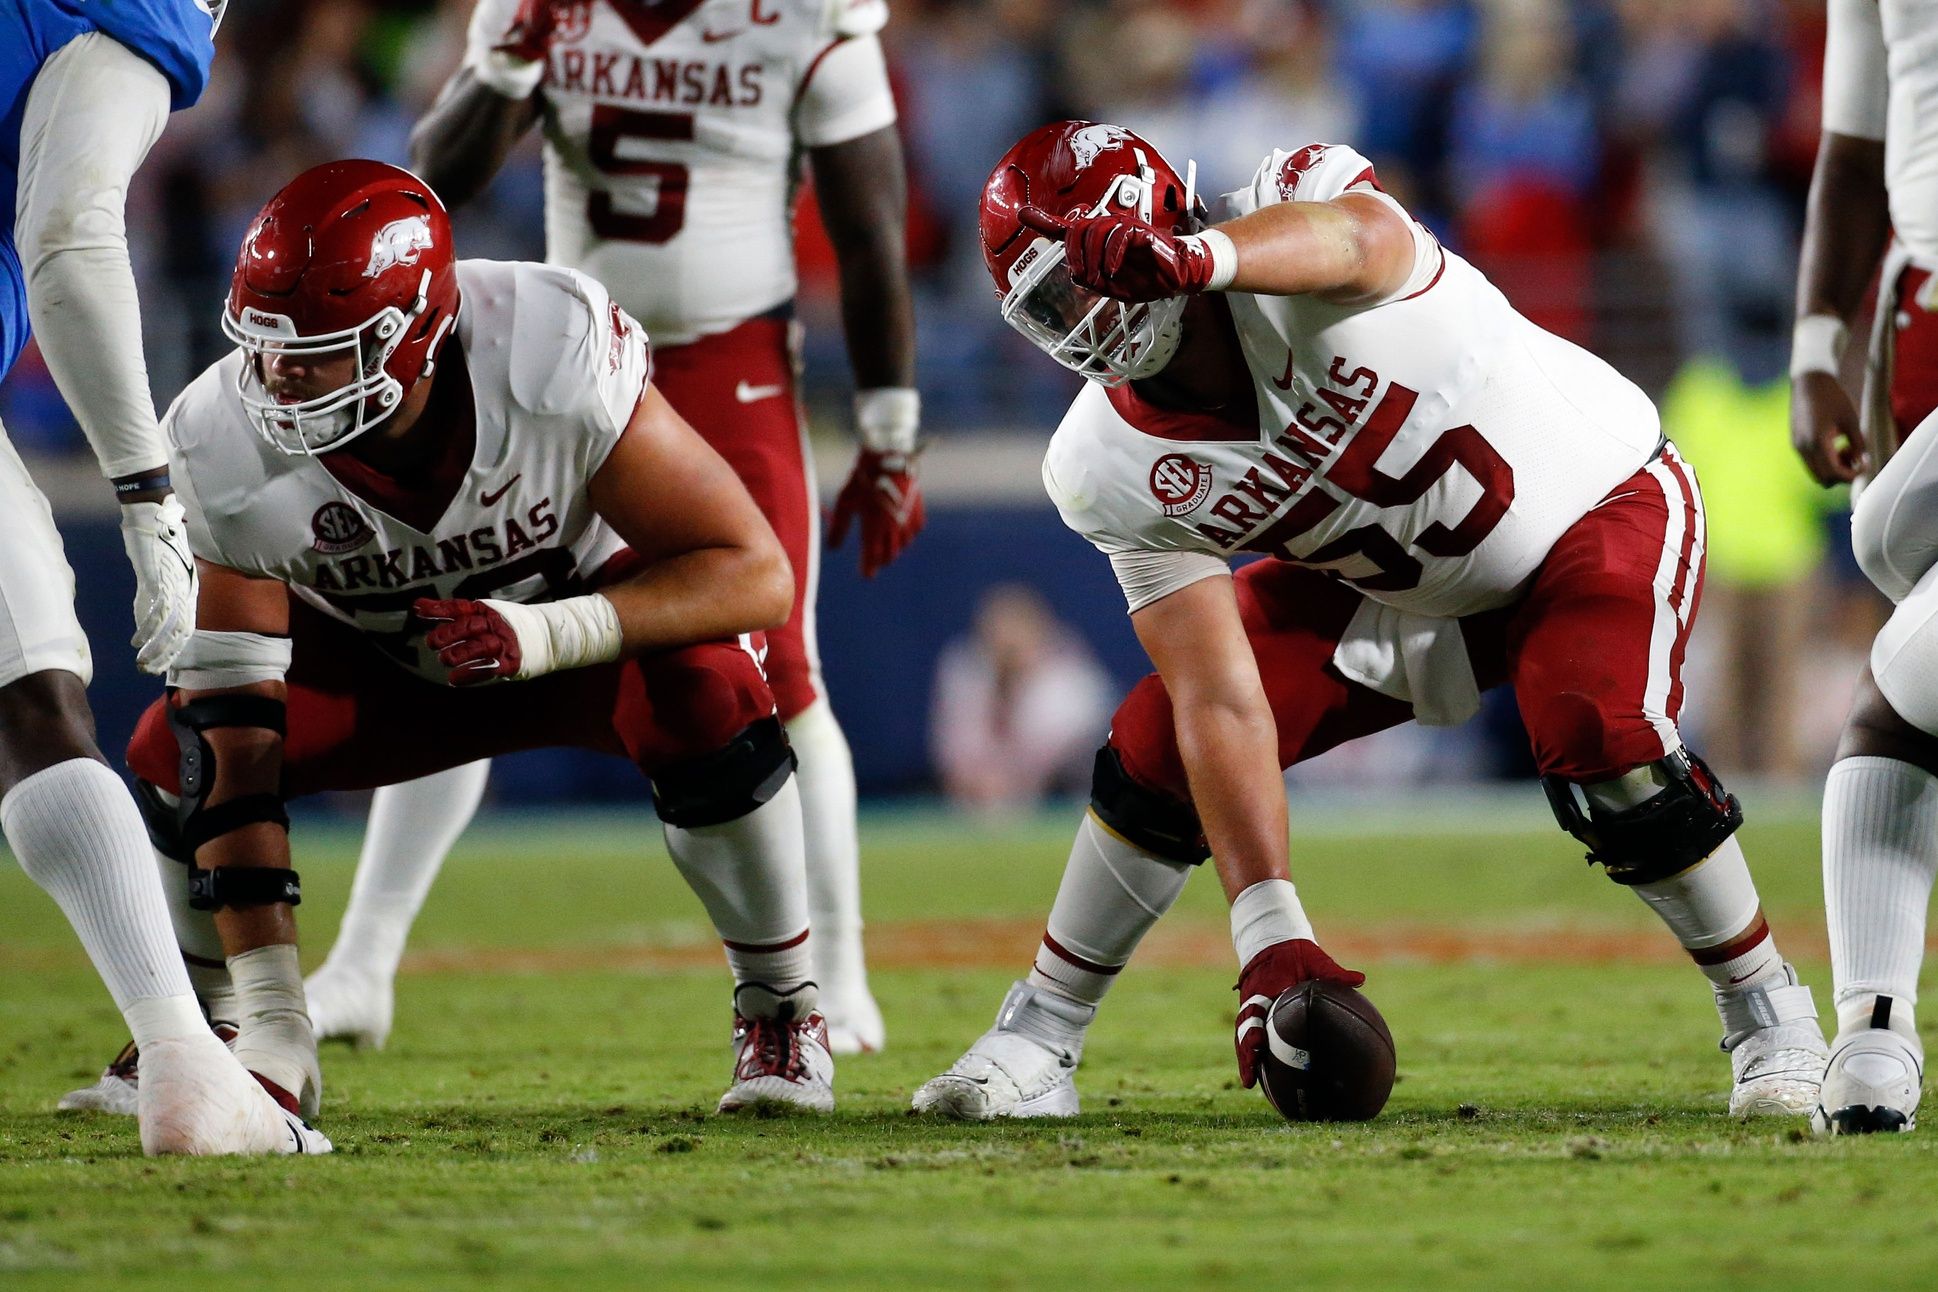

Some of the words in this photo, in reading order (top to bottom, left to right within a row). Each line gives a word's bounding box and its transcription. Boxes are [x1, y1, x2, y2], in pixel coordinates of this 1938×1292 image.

[543, 50, 763, 108] ARKANSAS
[588, 103, 696, 245] 5
[1012, 246, 1039, 277] HOGS
[250, 312, 279, 329] HOGS
[1194, 356, 1379, 550] ARKANSAS
[1154, 458, 1194, 499] SEC
[1176, 477, 1209, 513] GRADUATE
[1231, 380, 1516, 591] 55
[318, 506, 359, 540] SEC
[322, 532, 374, 552] GRADUA
[313, 497, 559, 591] ARKANSAS
